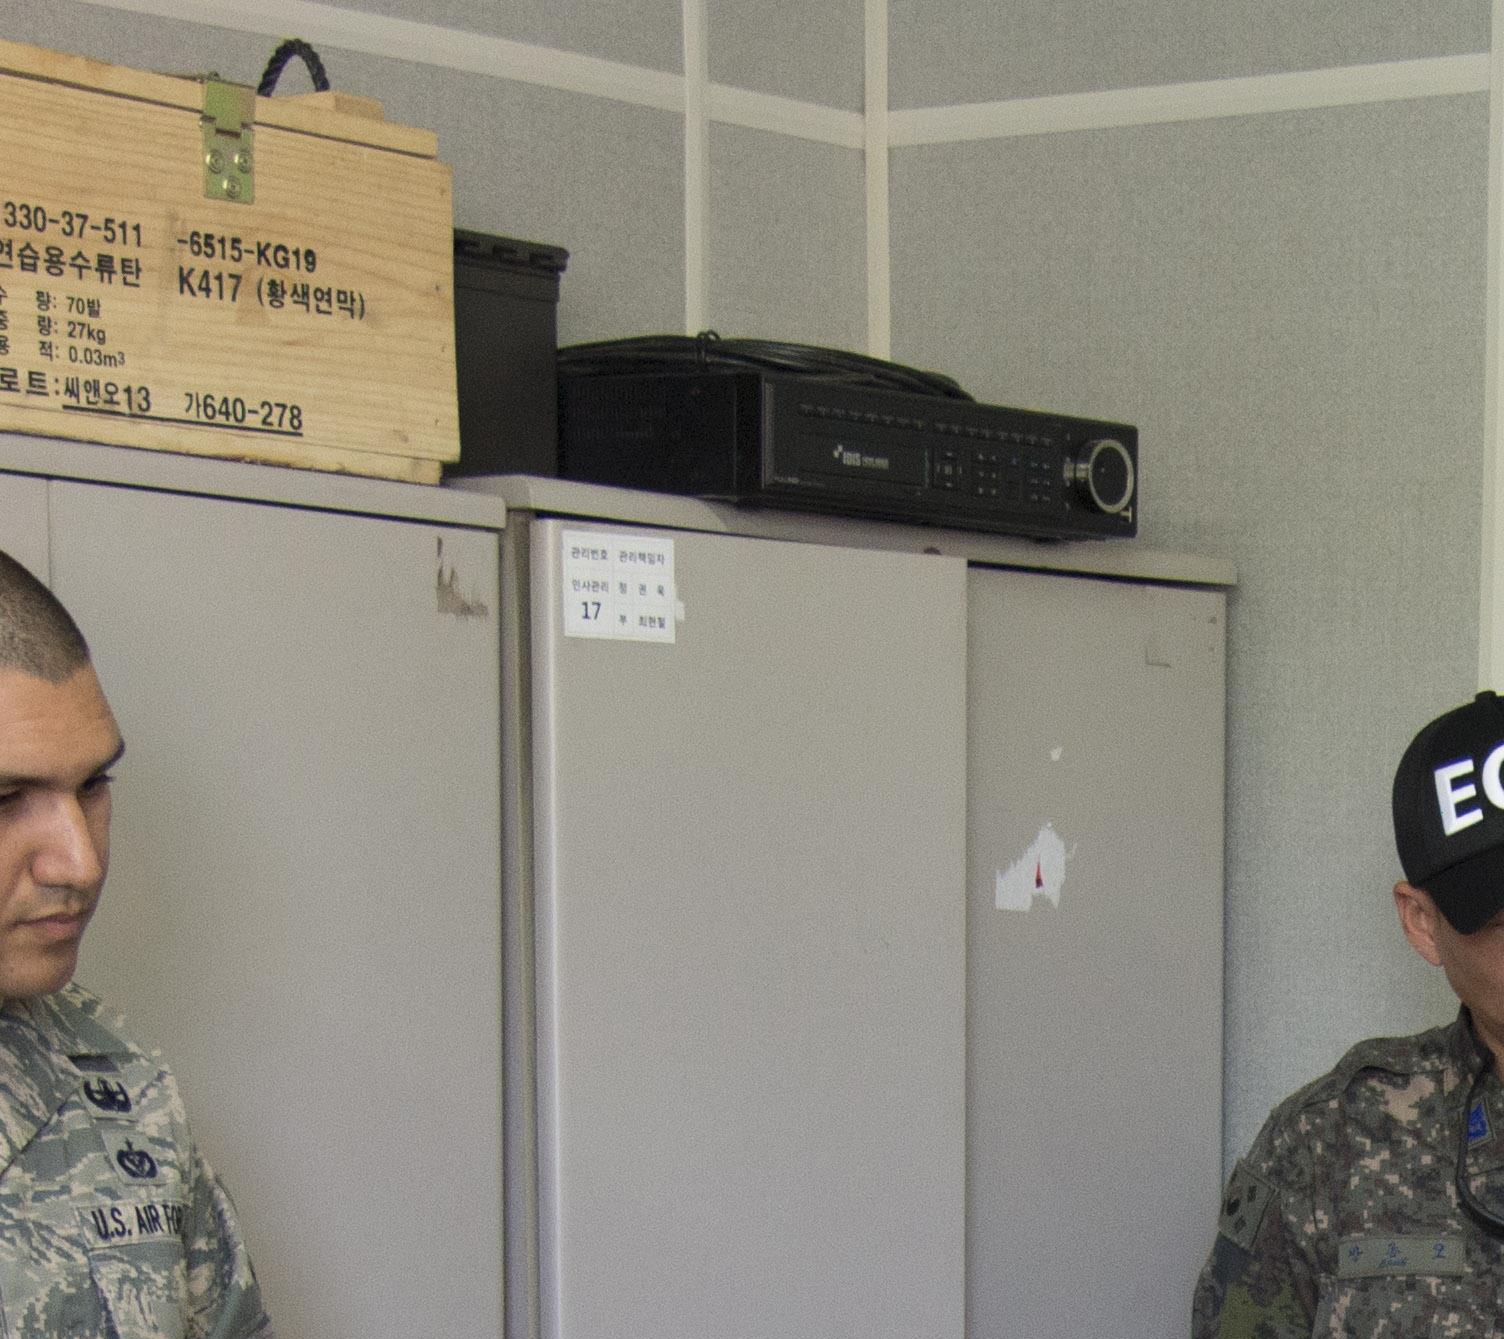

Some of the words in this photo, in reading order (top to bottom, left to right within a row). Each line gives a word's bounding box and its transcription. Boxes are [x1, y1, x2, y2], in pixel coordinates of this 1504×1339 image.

[178, 264, 243, 303] K417
[256, 276, 366, 321] (황색연막)
[65, 295, 101, 319] 70발
[67, 321, 107, 346] 27kg
[185, 391, 304, 431] 가640-278
[571, 546, 609, 561] 관리번호
[619, 550, 665, 566] 관리책임자
[581, 601, 602, 621] 17
[90, 1206, 133, 1242] U.S.
[134, 1203, 165, 1235] AIR
